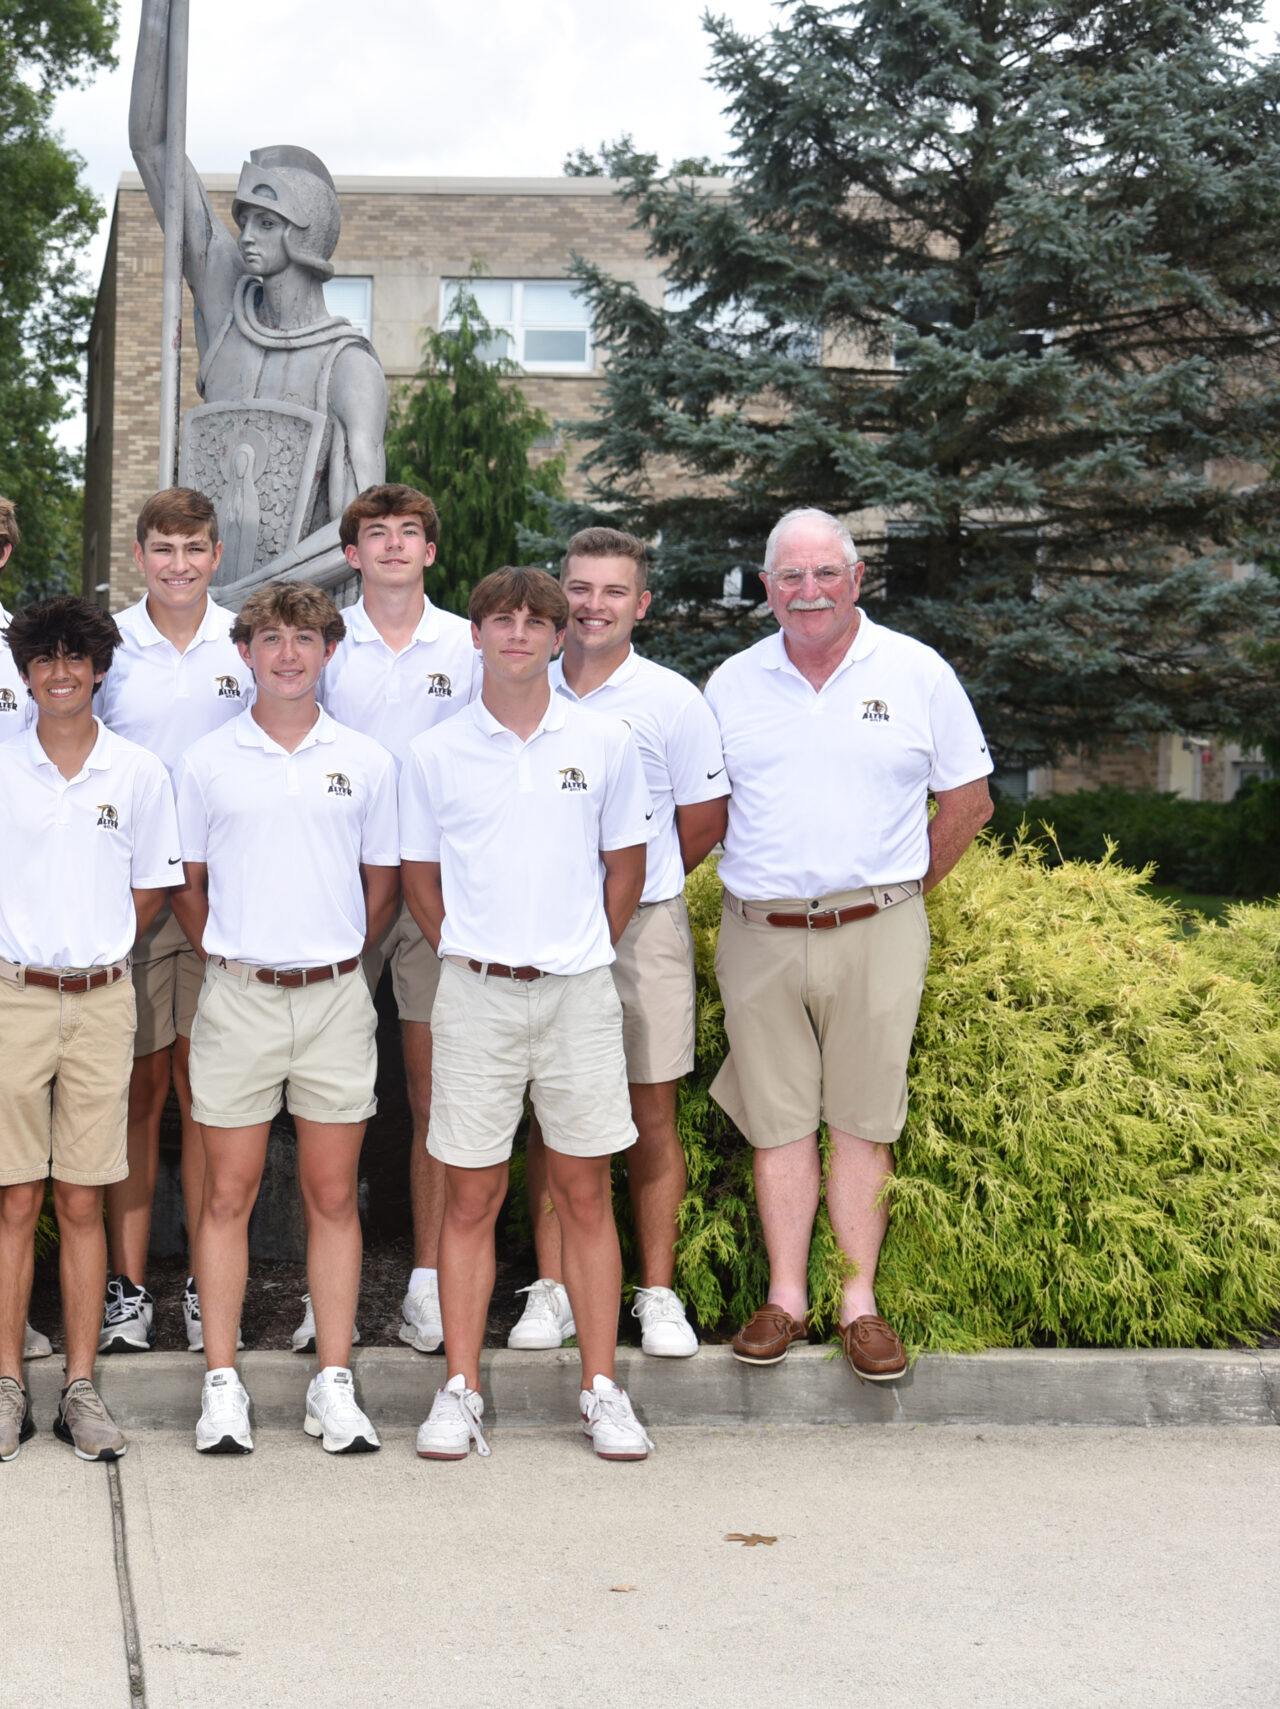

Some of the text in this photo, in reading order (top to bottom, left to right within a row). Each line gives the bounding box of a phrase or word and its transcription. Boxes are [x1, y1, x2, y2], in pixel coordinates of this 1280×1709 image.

[218, 688, 240, 697] ALTER
[428, 686, 452, 697] ALTER
[862, 712, 890, 722] ALTER
[327, 785, 352, 797] ALTER
[561, 781, 587, 791] ALTER
[97, 817, 118, 830] ALTER
[883, 893, 893, 905] A
